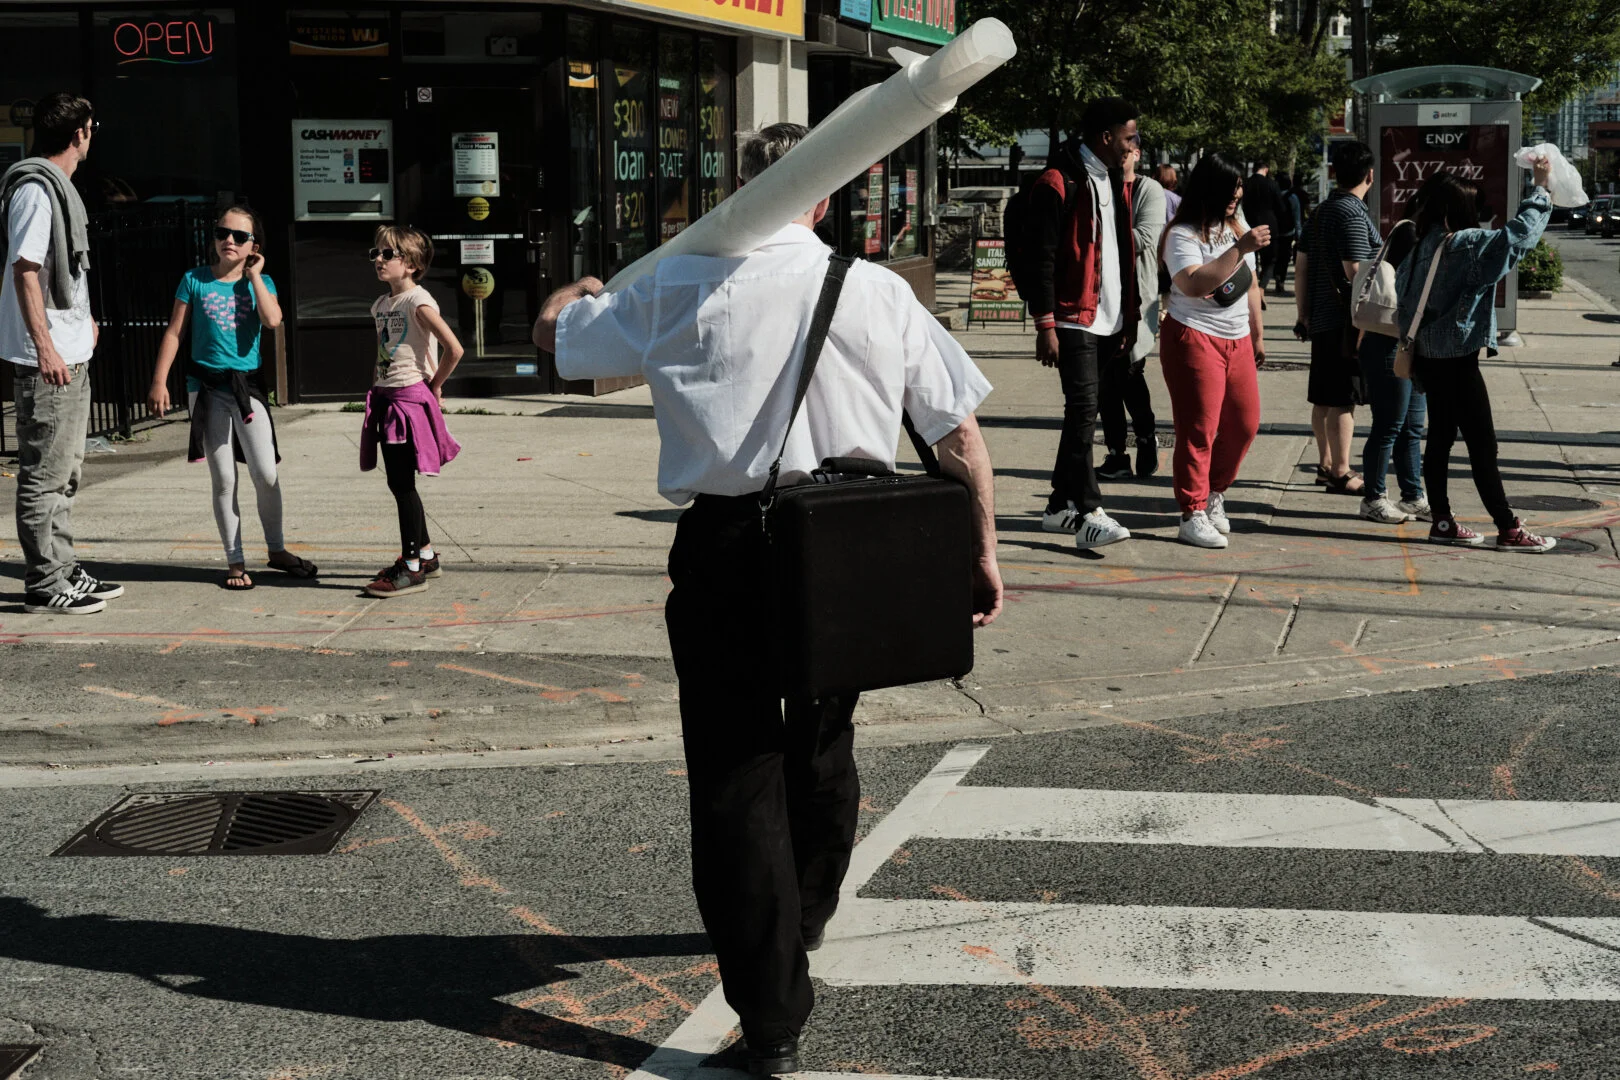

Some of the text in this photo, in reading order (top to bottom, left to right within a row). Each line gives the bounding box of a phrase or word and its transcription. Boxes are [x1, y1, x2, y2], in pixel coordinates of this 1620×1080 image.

[114, 21, 213, 55] OPEN
[614, 99, 645, 138] $300
[660, 98, 679, 118] NEW
[700, 105, 724, 140] $300
[301, 130, 381, 141] CASHMONEY
[660, 127, 687, 150] LOWER
[1425, 133, 1464, 144] ENDY
[614, 140, 645, 180] loan
[659, 152, 683, 179] RATE
[700, 142, 725, 179] loan
[624, 191, 645, 228] $20
[974, 310, 1020, 319] PIZZA NOVA
